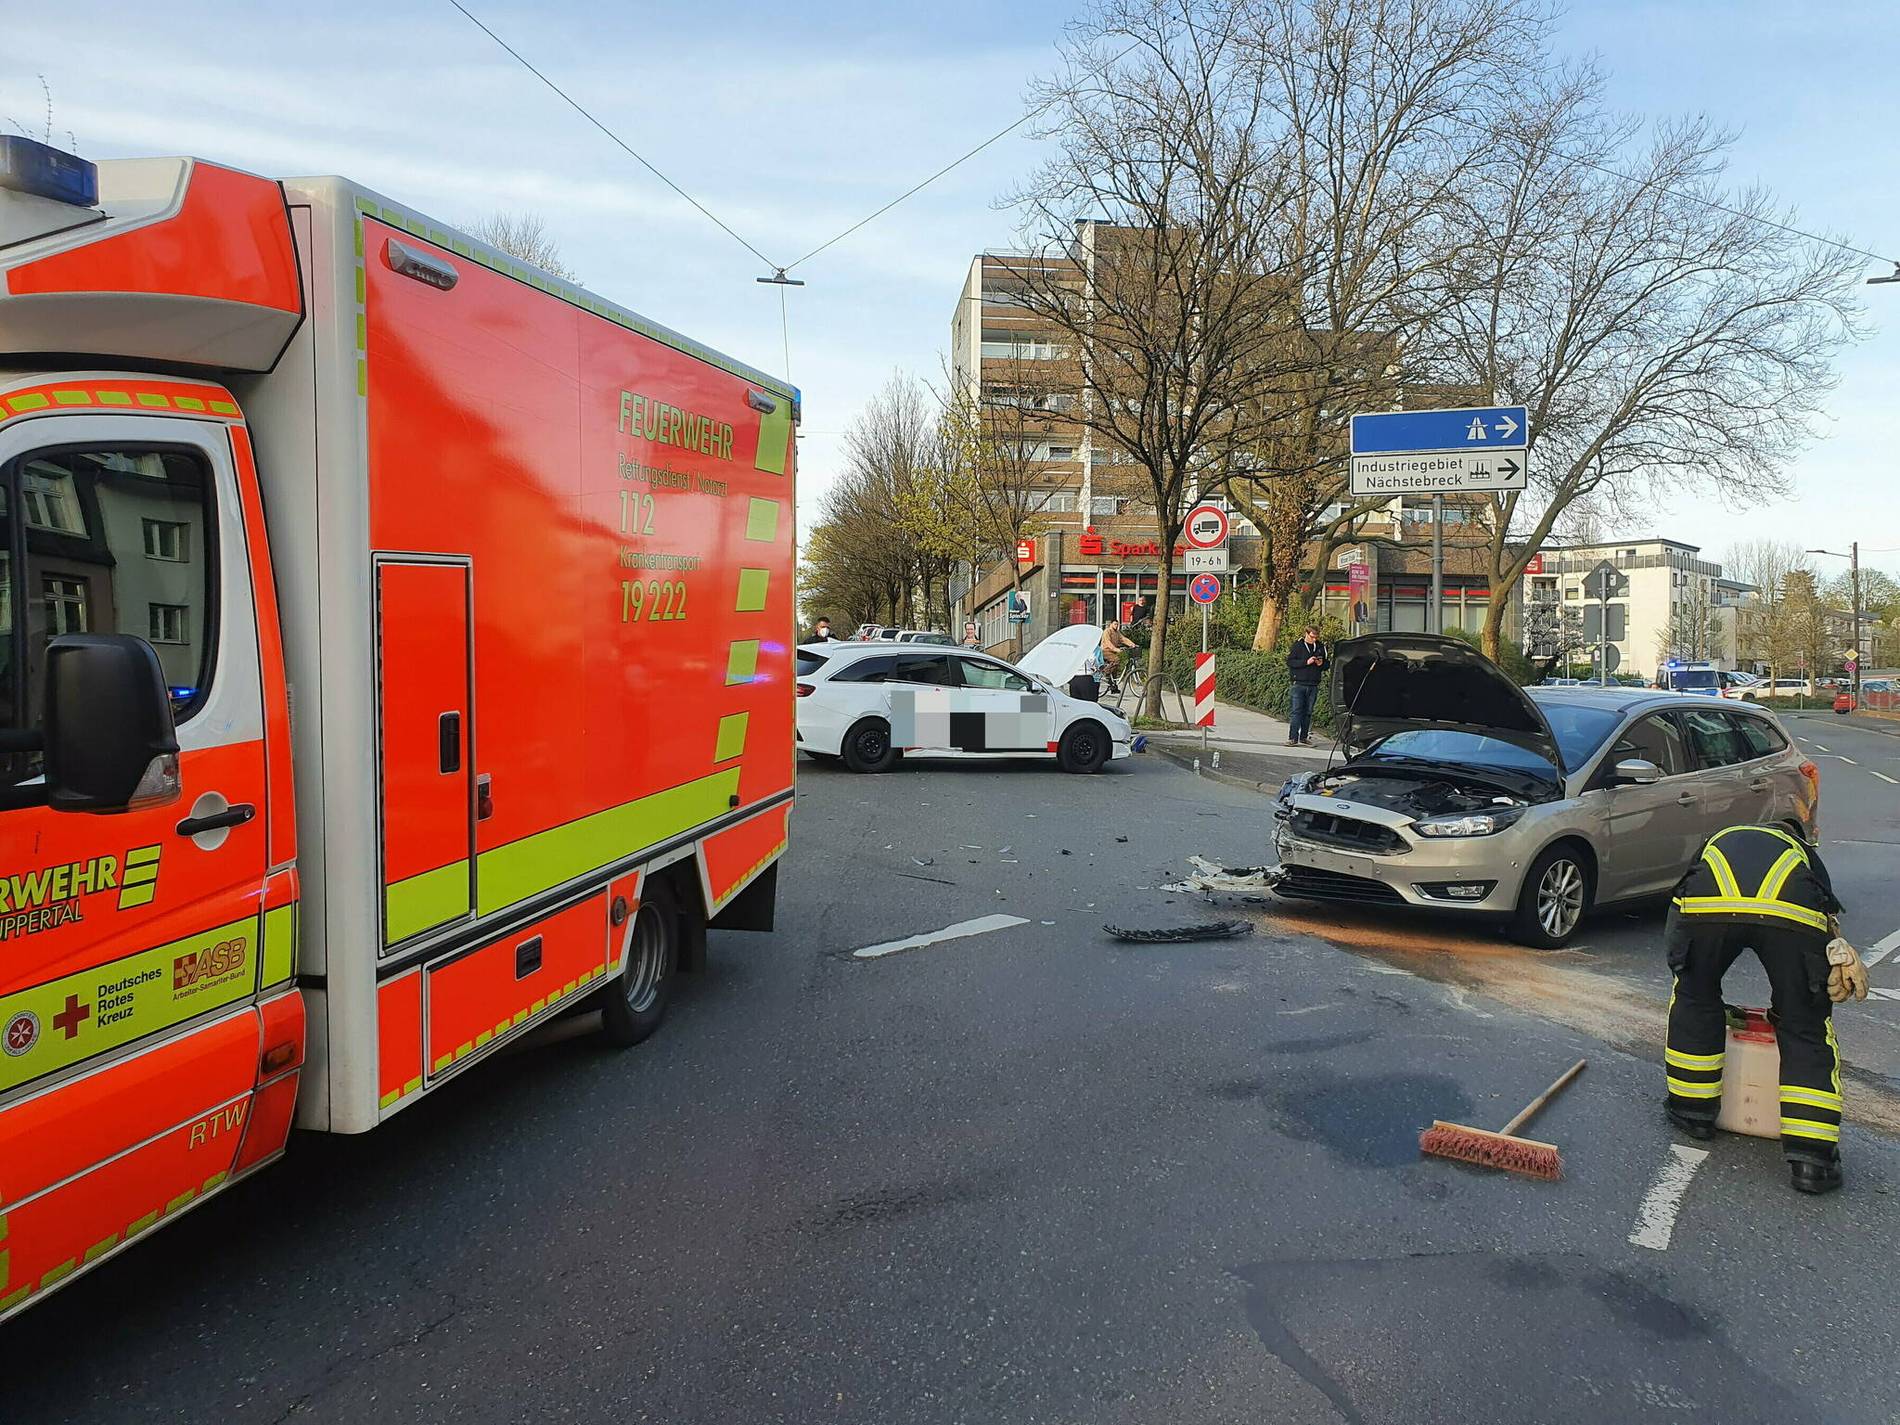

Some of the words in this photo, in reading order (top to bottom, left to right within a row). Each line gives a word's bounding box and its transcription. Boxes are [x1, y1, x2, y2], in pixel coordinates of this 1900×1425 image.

[618, 389, 735, 462] FEUERWEHR
[618, 452, 690, 490] Rettungsdienst
[1357, 458, 1463, 473] Industriegebiet
[1366, 474, 1462, 488] Nächstebreck
[619, 490, 655, 535] 112
[619, 545, 703, 576] Krankentransport
[1110, 540, 1194, 558] Sparks
[189, 936, 247, 985] ASB
[97, 968, 162, 999] Deutsches
[97, 992, 134, 1014] Rotes
[97, 1006, 134, 1028] Kreuz
[188, 1100, 249, 1151] RTW
